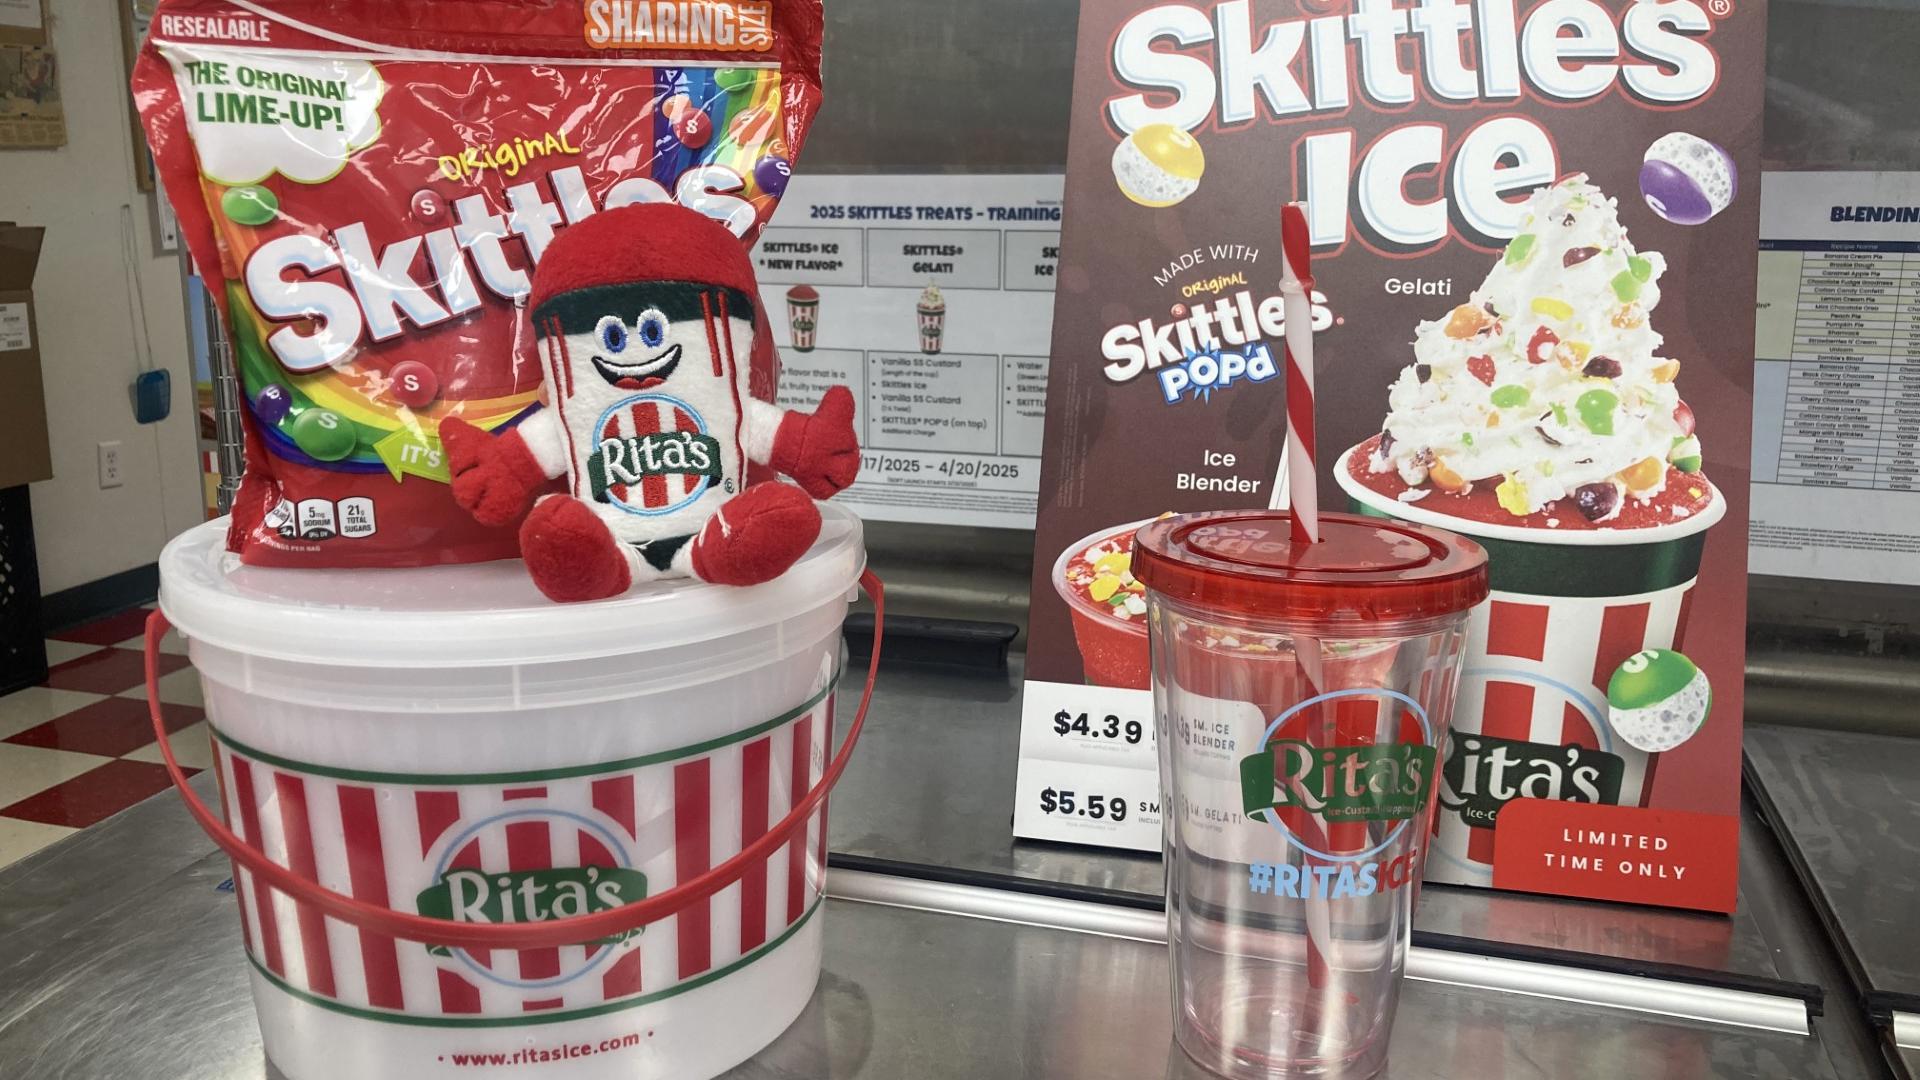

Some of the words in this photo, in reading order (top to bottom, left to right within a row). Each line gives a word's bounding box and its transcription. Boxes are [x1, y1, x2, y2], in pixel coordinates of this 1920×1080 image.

[161, 15, 271, 42] RESEALABLE
[589, 0, 737, 47] SHARING
[738, 3, 768, 47] SIZE
[184, 61, 230, 87] THE
[236, 66, 355, 101] ORIGINAL
[197, 91, 345, 132] LIME-UP!
[810, 205, 844, 220] 2025
[847, 206, 913, 220] SKITTLES
[1830, 206, 1920, 223] BLENDIN
[246, 164, 757, 373] Skitts
[768, 259, 793, 270] NEW
[1153, 248, 1205, 287] MADE
[1209, 244, 1259, 263] WITH
[1384, 277, 1452, 296] Gelati
[1016, 398, 1045, 407] SKITTL
[401, 444, 441, 468] IT'S
[599, 431, 711, 486] Rita's
[861, 454, 920, 473] /17/2025
[938, 459, 1019, 478] 4/20/2025
[1203, 450, 1236, 467] Ice
[1176, 473, 1261, 494] Blender
[344, 524, 371, 533] SUGARS
[1053, 708, 1142, 744] $4.39
[1272, 742, 1423, 810] Rita's
[1040, 786, 1127, 821] $5.59
[1139, 801, 1160, 814] SM
[1564, 829, 1669, 851] LIMITED
[1544, 853, 1604, 872] TIME
[1619, 861, 1686, 880] ONLY
[446, 867, 624, 924] Rita's
[452, 1032, 640, 1067] www.ritasice.com
